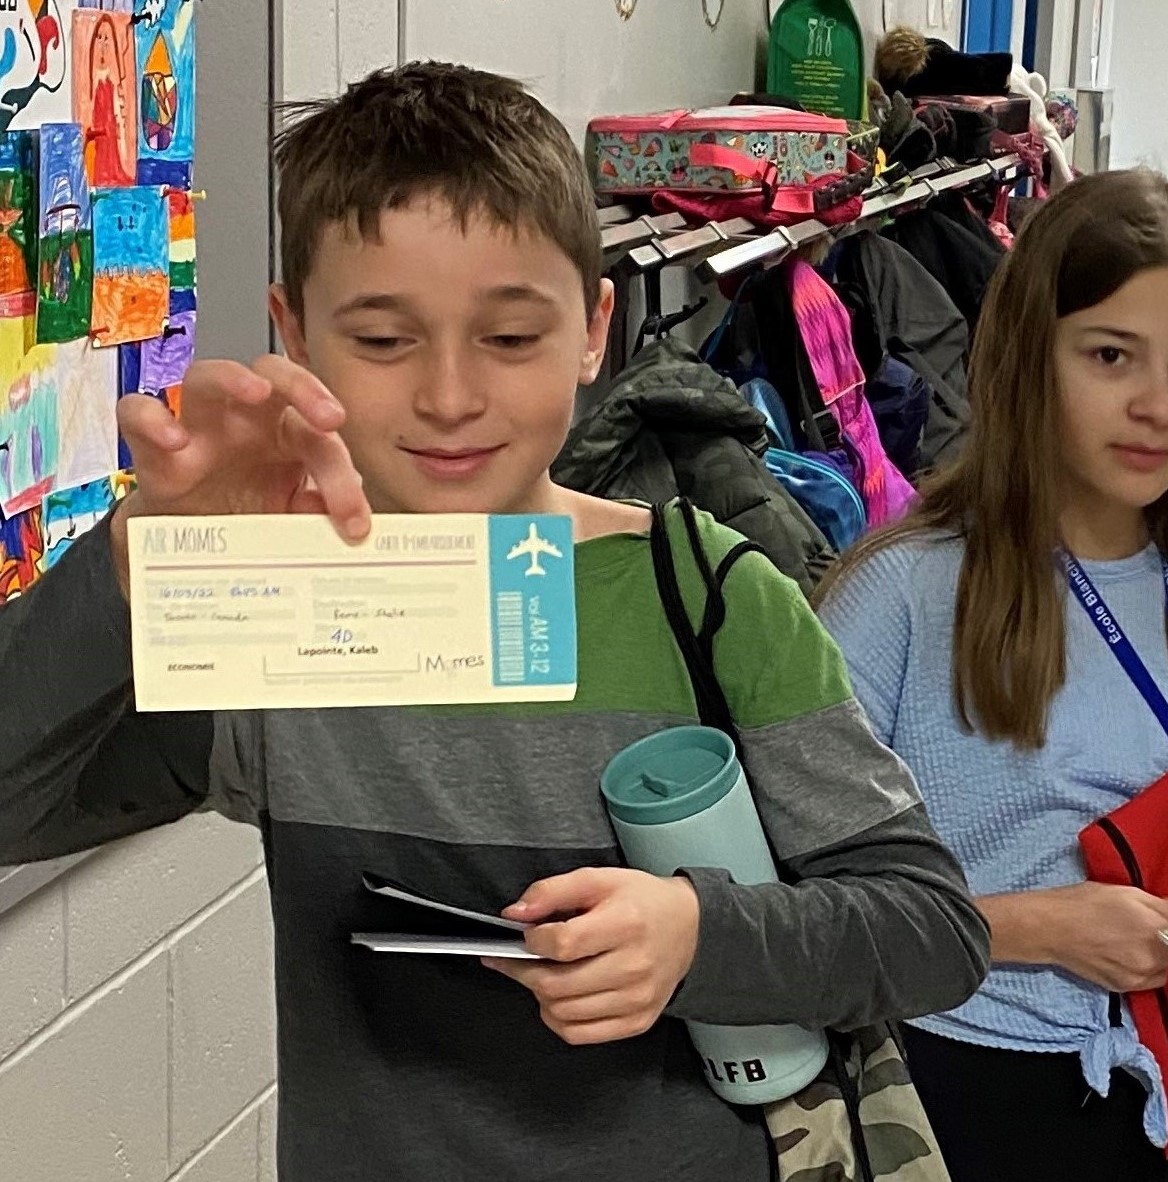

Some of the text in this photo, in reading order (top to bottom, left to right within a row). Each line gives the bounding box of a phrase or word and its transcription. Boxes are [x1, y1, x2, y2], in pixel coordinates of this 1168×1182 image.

[298, 645, 378, 657] Lapointe, Kaleb
[707, 1058, 767, 1083] LFB
